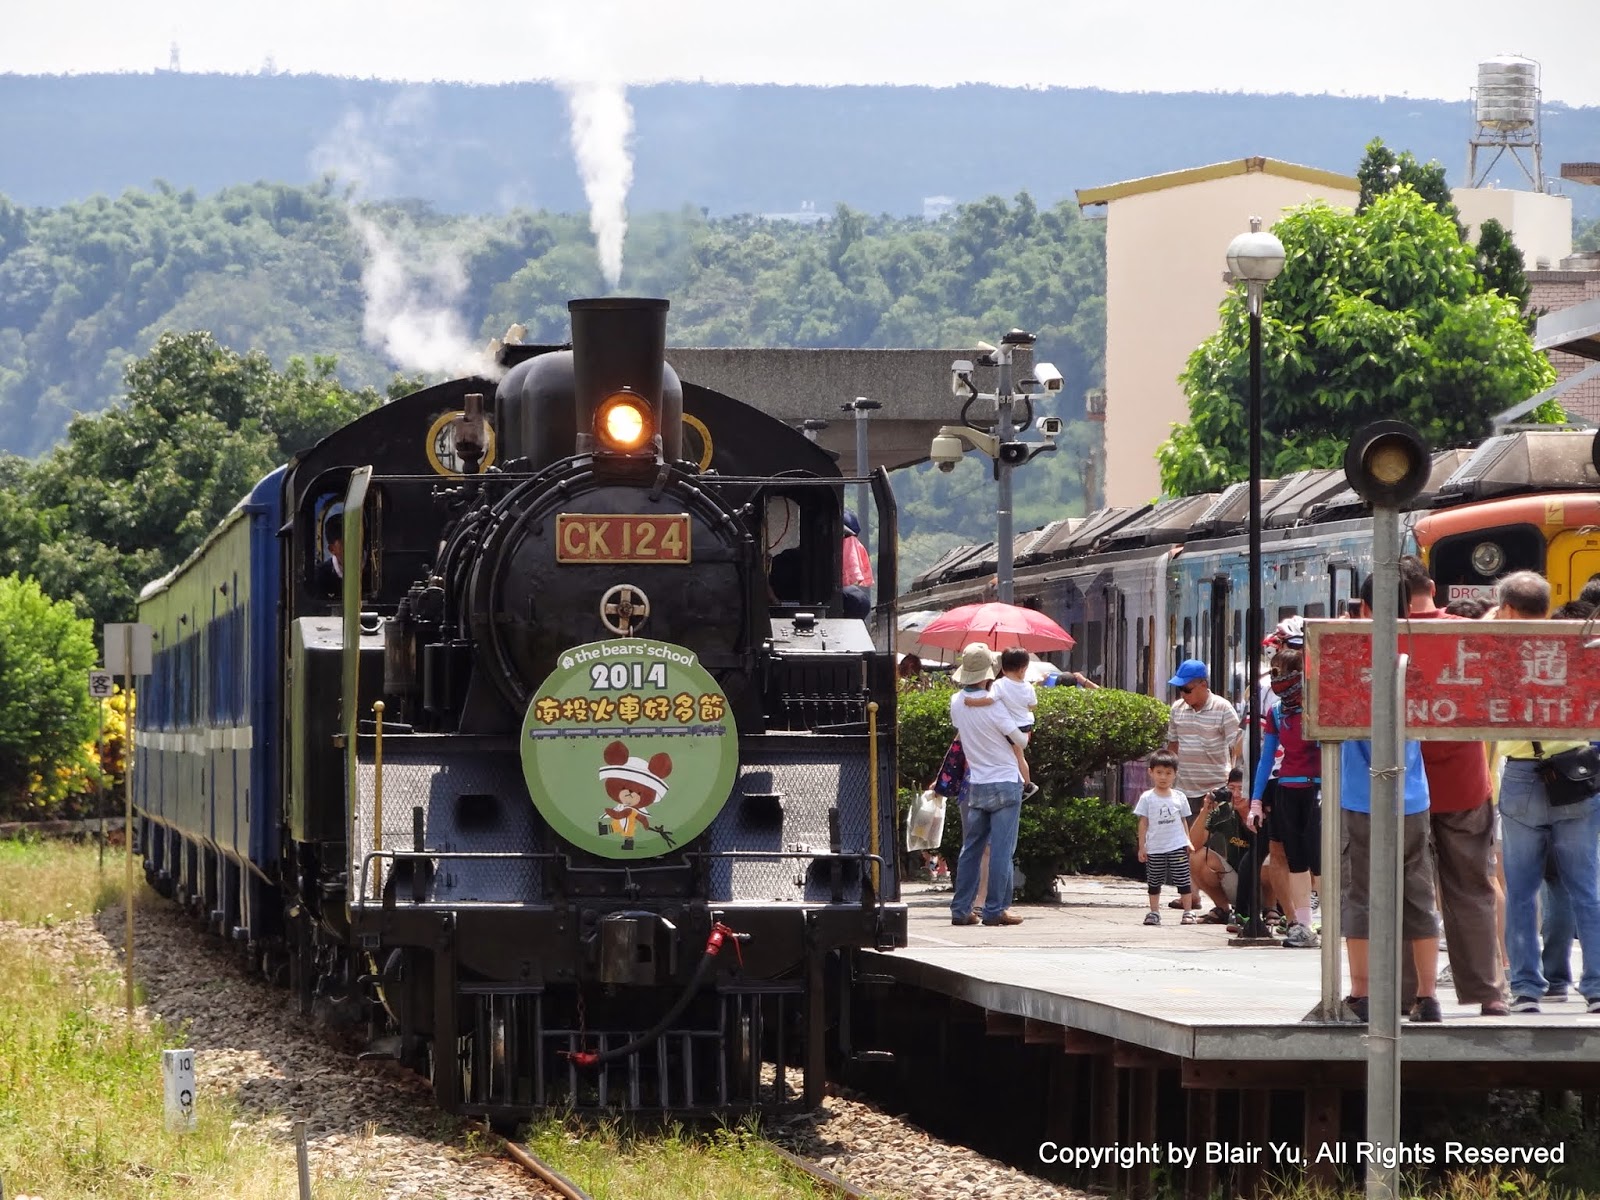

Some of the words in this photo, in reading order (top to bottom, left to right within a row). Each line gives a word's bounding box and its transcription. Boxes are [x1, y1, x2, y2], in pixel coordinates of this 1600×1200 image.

[564, 521, 611, 555] CK
[622, 521, 683, 557] 124
[1451, 587, 1480, 599] DRC
[574, 648, 600, 664] the
[648, 645, 695, 668] school
[92, 675, 111, 694] 客
[590, 661, 667, 691] 2014
[535, 692, 727, 724] 南投火車好多節
[1406, 698, 1458, 723] NO
[179, 1058, 191, 1072] 10
